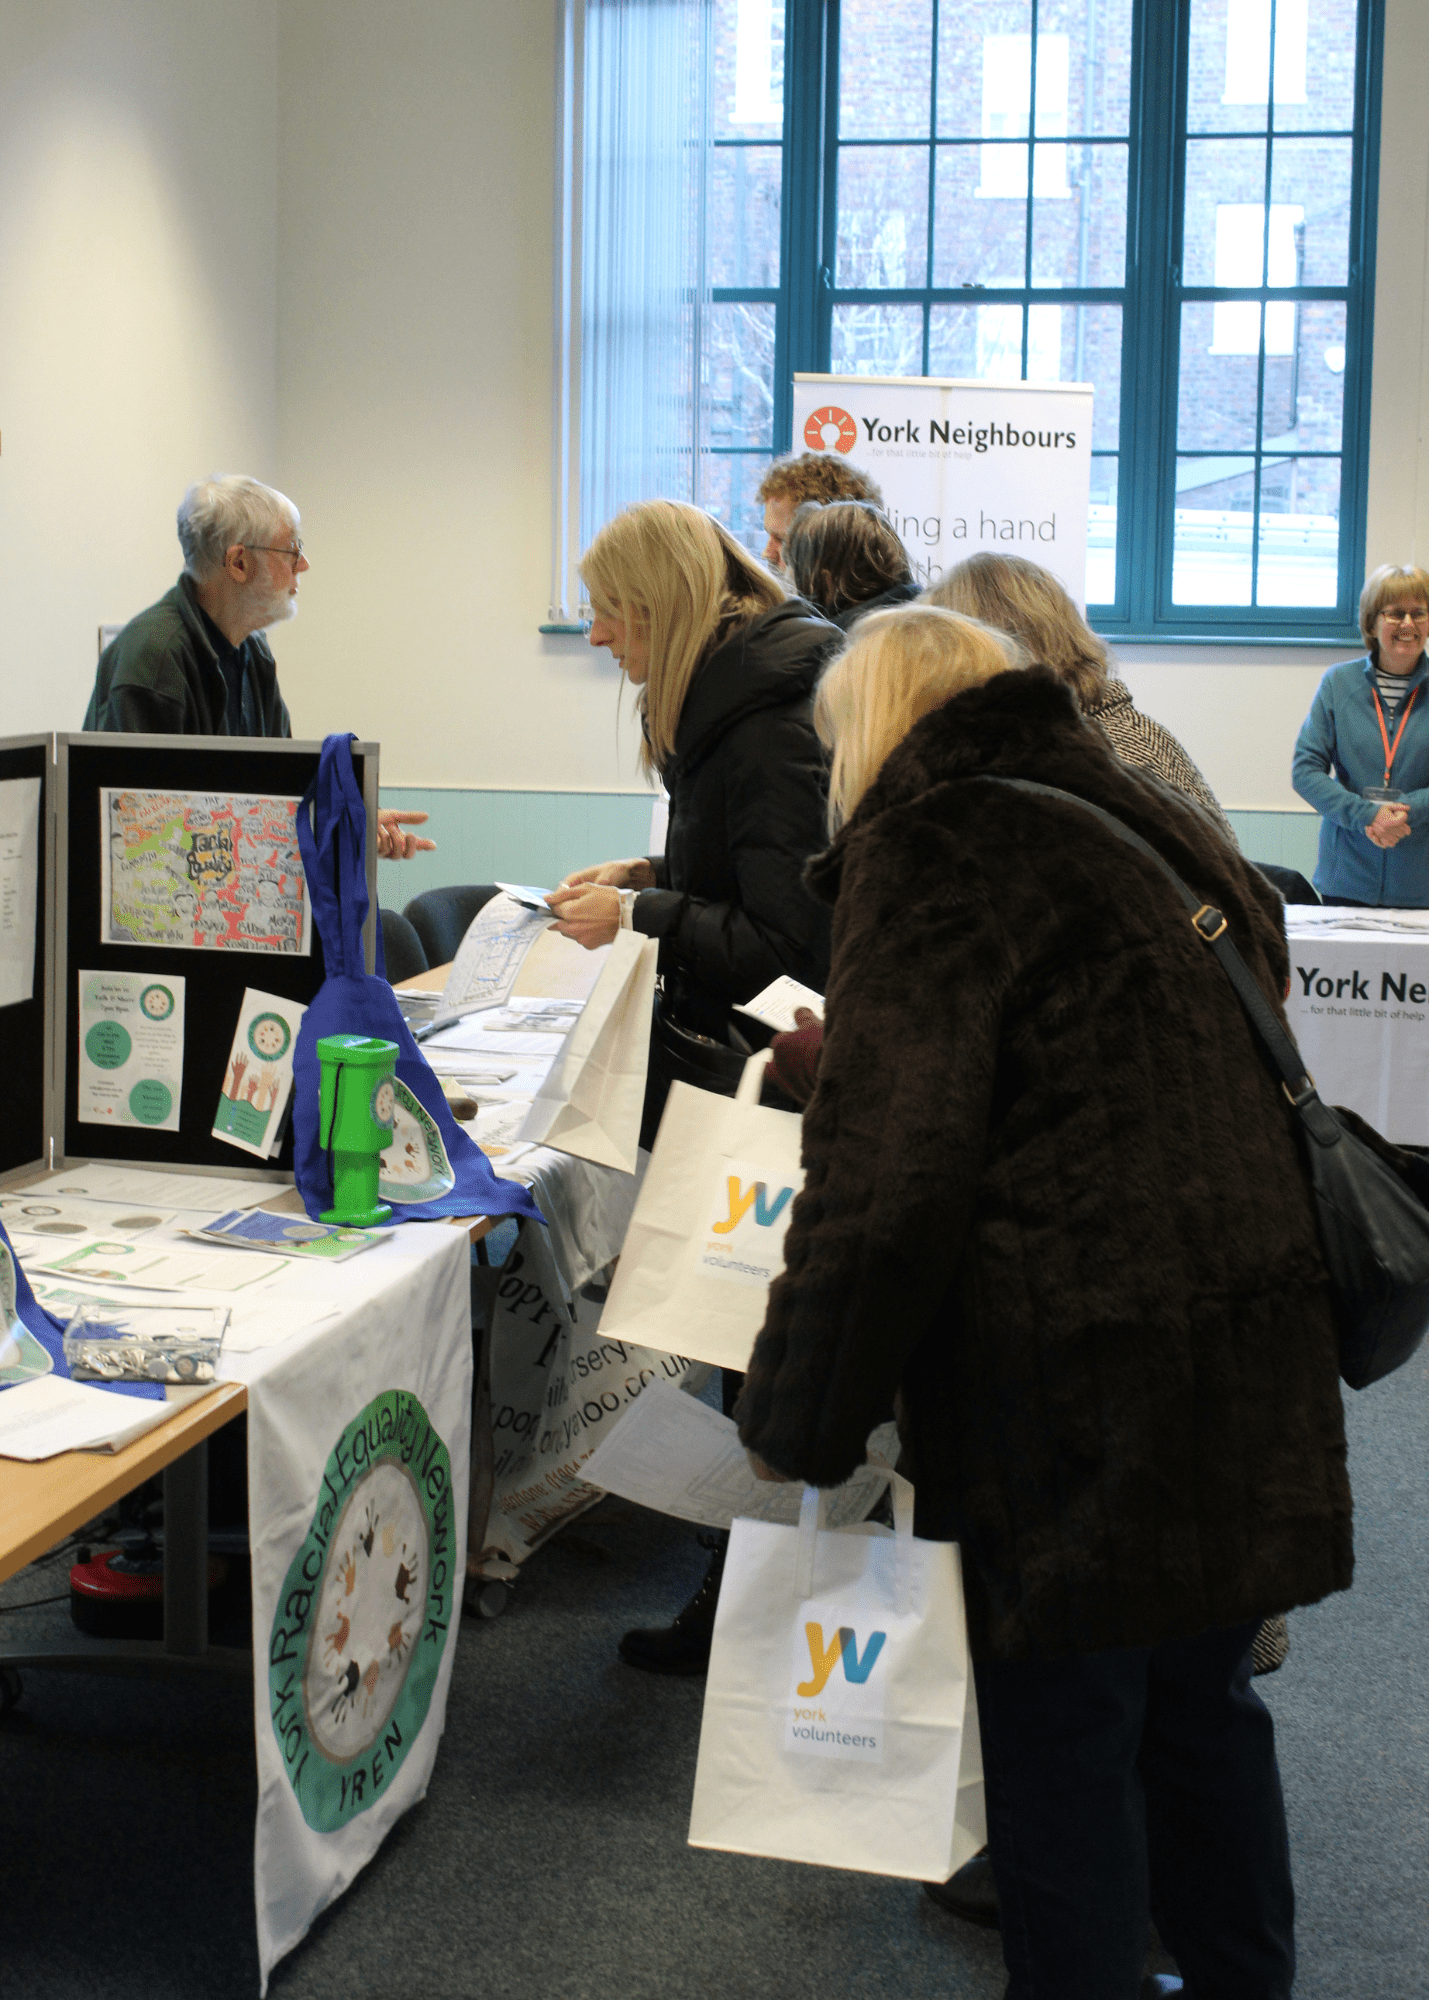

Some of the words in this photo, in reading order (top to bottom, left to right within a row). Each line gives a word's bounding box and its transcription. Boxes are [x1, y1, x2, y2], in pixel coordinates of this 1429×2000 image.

[862, 417, 920, 444] York
[930, 420, 1076, 453] Neighbours
[886, 448, 903, 457] that
[906, 449, 927, 458] little
[929, 450, 941, 458] bit
[954, 451, 973, 461] help
[952, 517, 968, 540] a
[980, 510, 1057, 542] hand
[1295, 966, 1370, 1000] York
[1380, 971, 1429, 1003] Ne
[1326, 1005, 1347, 1016] that
[1349, 1006, 1372, 1018] little
[1374, 1008, 1388, 1018] bit
[1402, 1010, 1426, 1022] help
[334, 1390, 420, 1488] Equality
[416, 1425, 450, 1645] Network
[270, 1472, 340, 1666] Racial
[272, 1672, 310, 1788] York
[793, 1707, 826, 1722] york
[792, 1725, 877, 1748] volunteers
